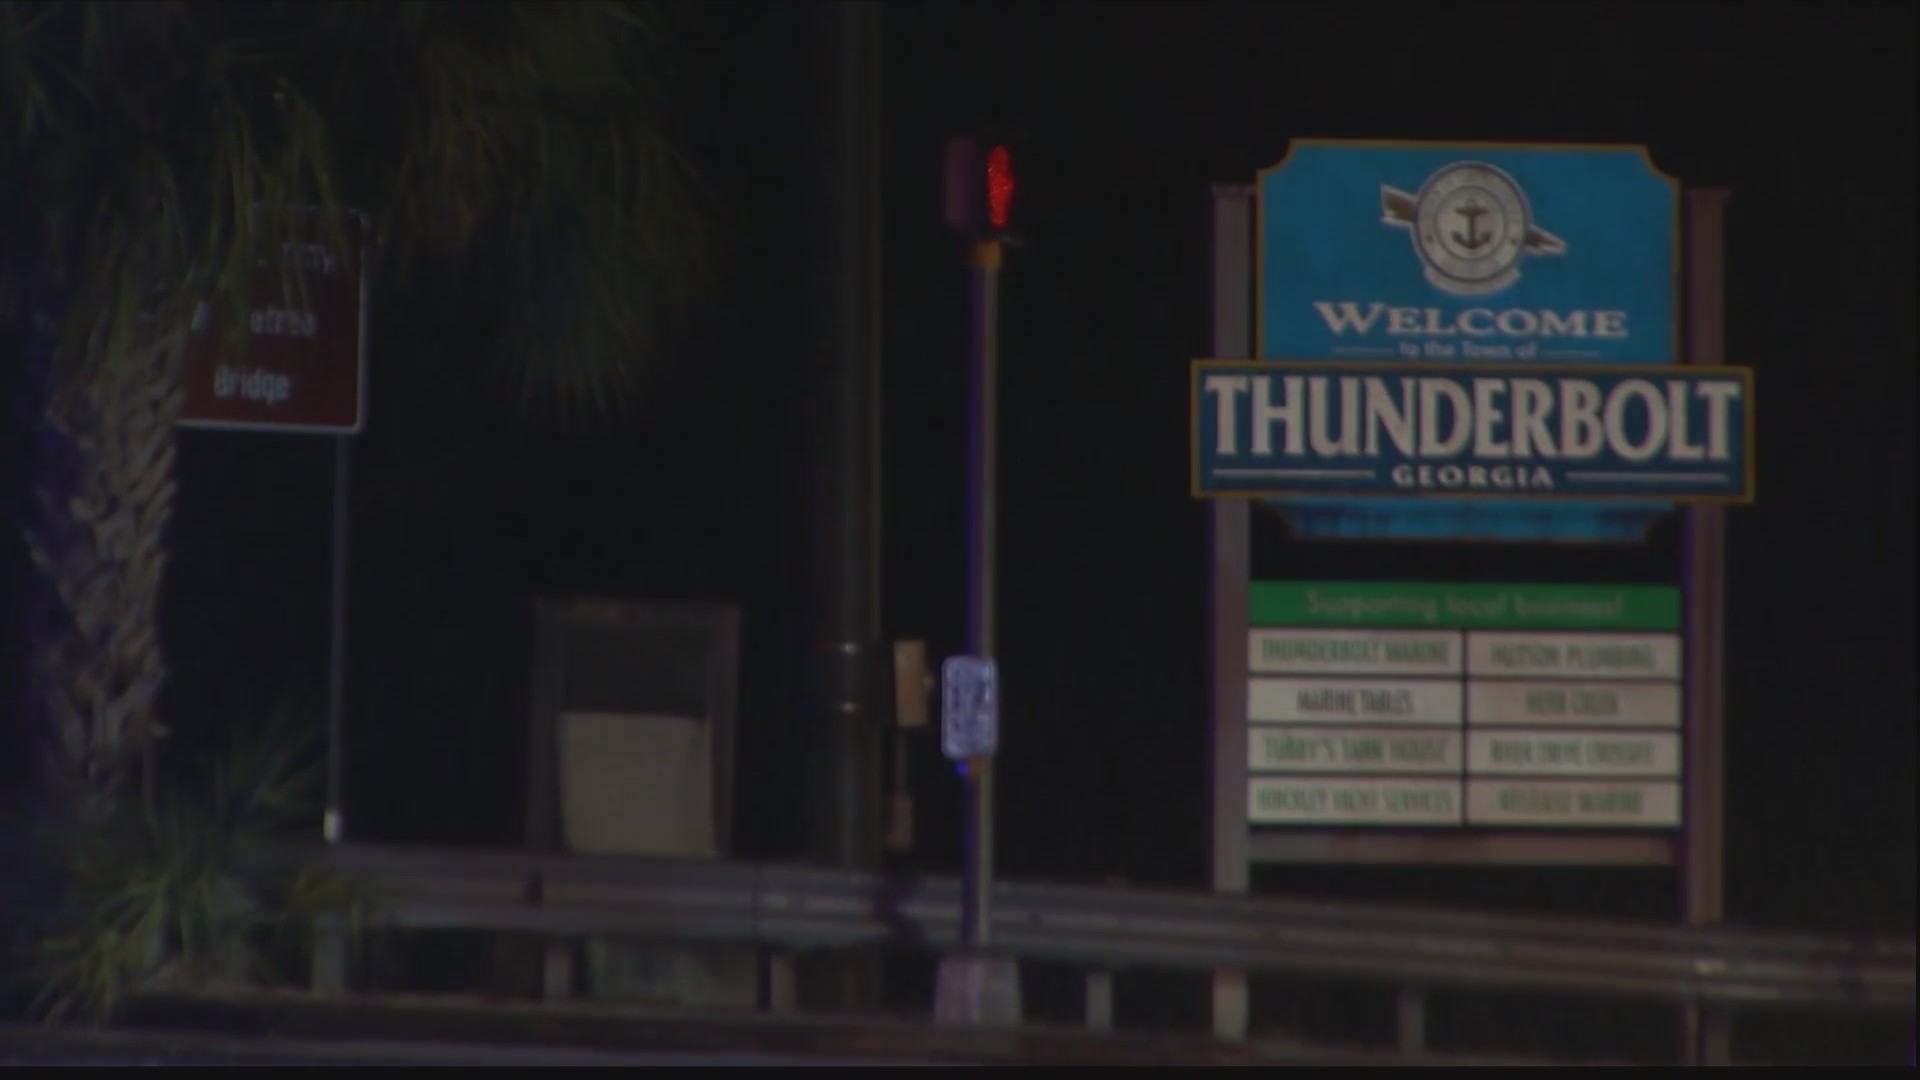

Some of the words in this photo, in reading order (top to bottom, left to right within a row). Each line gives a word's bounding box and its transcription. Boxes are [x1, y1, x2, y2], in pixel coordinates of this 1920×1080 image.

[1312, 300, 1629, 338] WELCOME
[1400, 341, 1419, 356] to
[1424, 341, 1455, 356] the
[1462, 341, 1512, 357] Town
[1516, 342, 1537, 358] of
[214, 366, 289, 405] Bridge
[1203, 376, 1743, 461] THUNDERBOLT
[1391, 464, 1553, 489] GEORGIA
[1306, 591, 1437, 621] Supporting
[1447, 591, 1505, 615] local
[1262, 638, 1379, 664] THUNDERBOLT
[1297, 688, 1356, 714] MARINE
